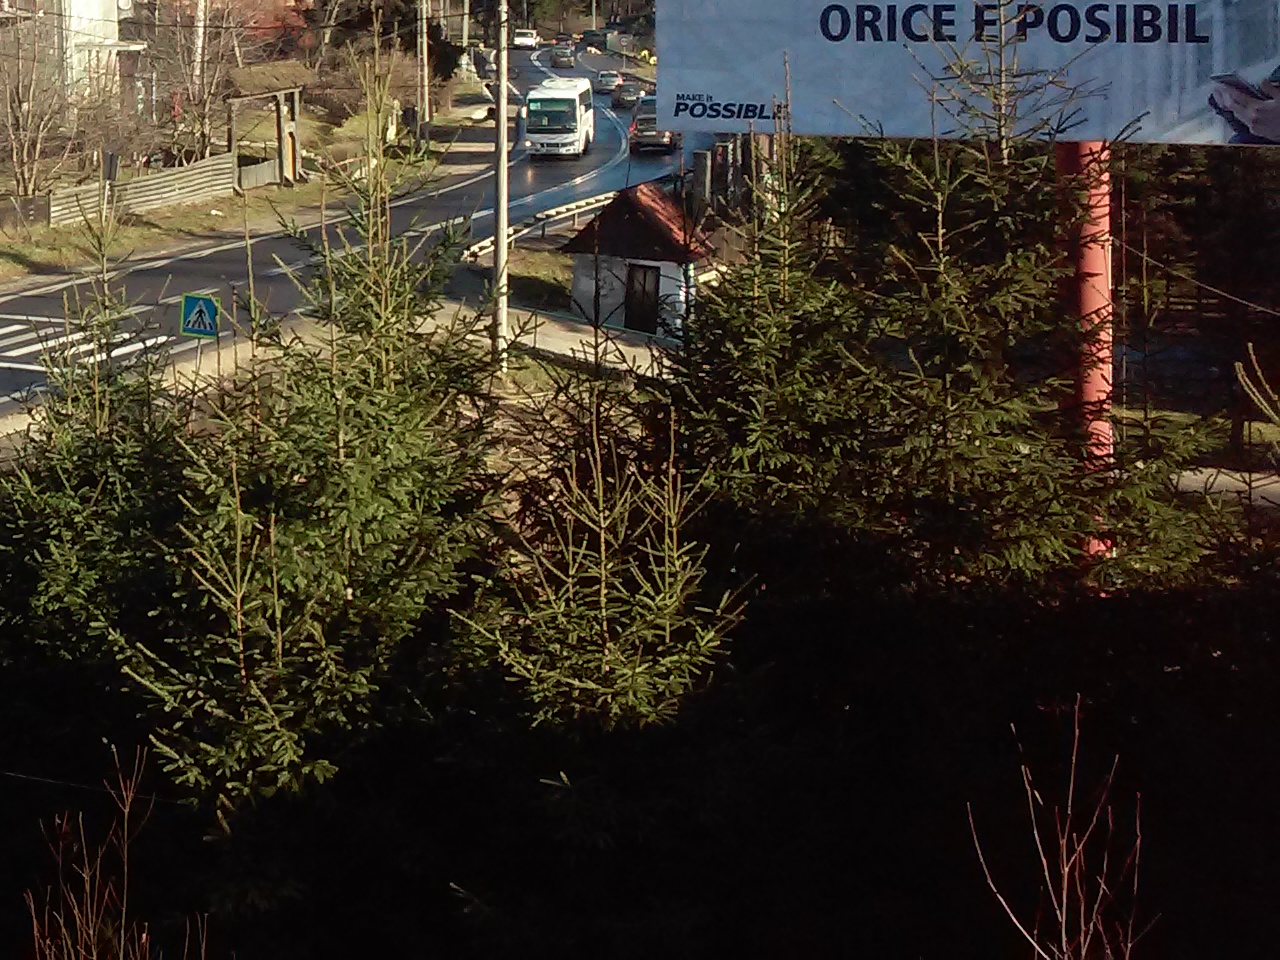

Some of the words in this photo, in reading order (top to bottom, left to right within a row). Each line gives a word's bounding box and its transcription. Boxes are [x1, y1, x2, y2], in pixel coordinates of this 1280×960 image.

[820, 3, 957, 42] ORICE
[974, 3, 1000, 42] E
[1016, 3, 1209, 43] POSIBIL
[676, 93, 704, 101] MAKE
